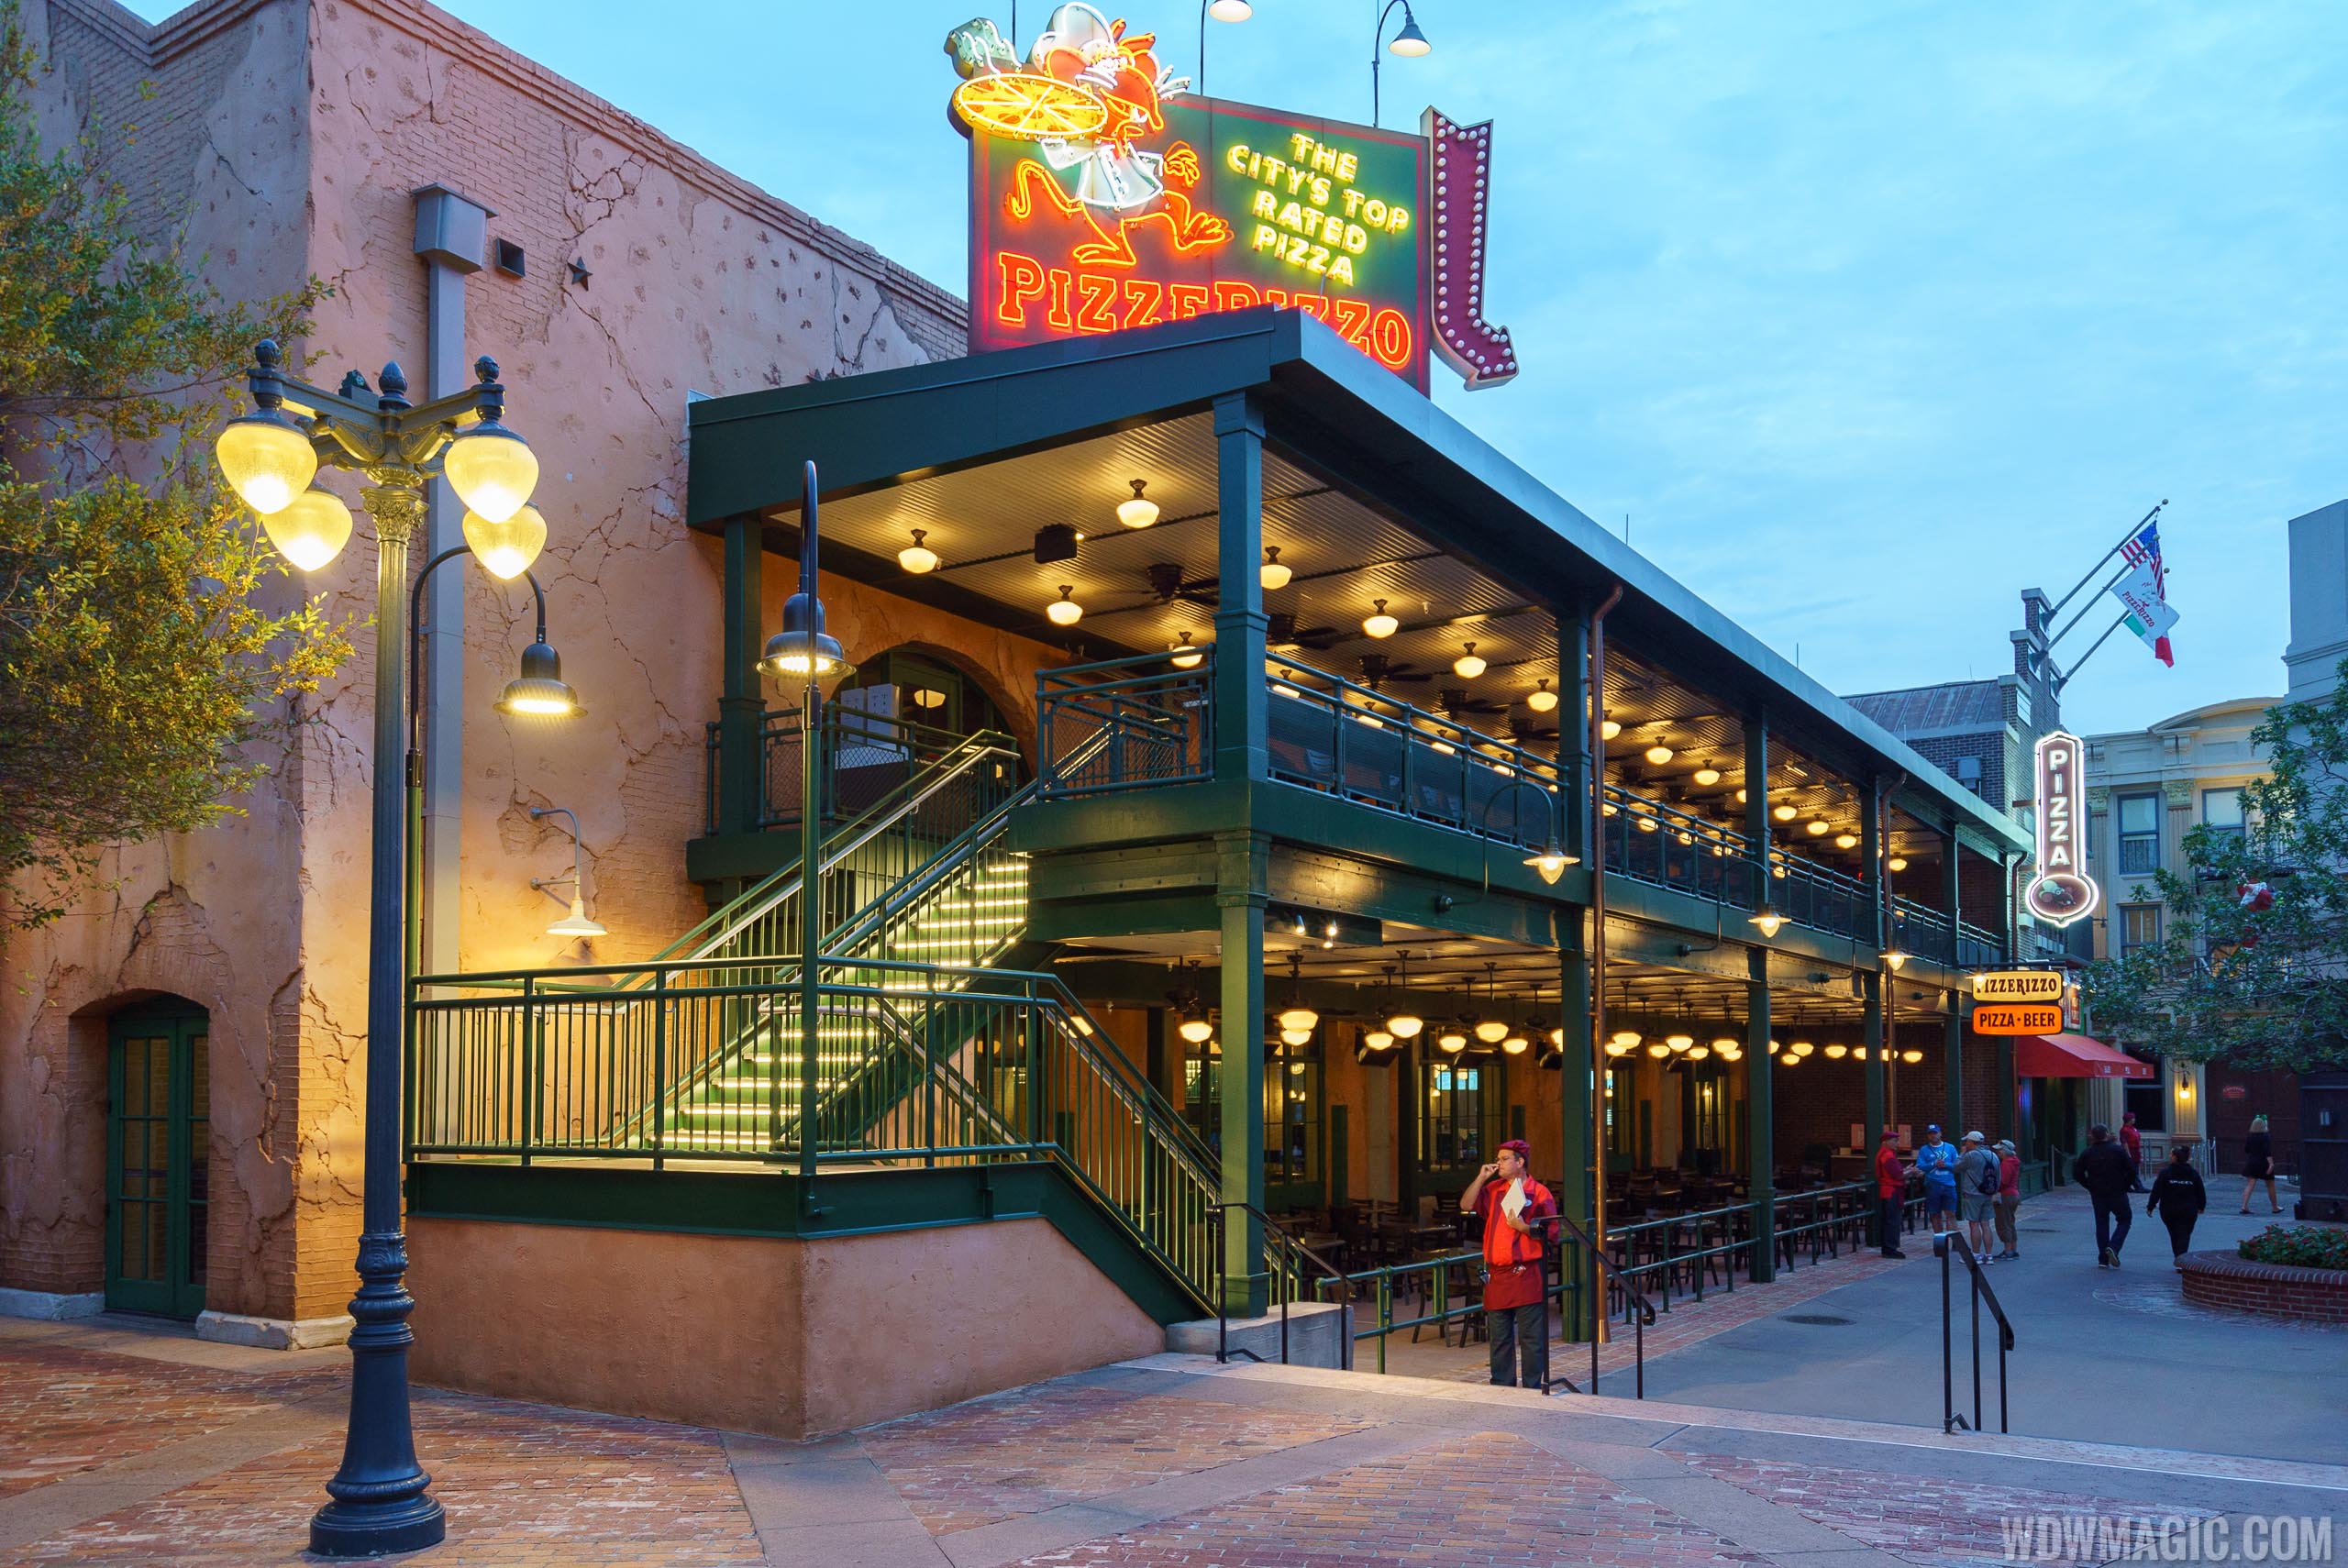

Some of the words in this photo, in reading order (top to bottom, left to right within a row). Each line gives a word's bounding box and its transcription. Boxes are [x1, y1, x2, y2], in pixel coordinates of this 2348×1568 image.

[1290, 133, 1358, 183] THE
[1227, 145, 1331, 206] CITY'S
[1342, 188, 1409, 234] TOP
[1253, 190, 1367, 254] RATED
[1252, 224, 1354, 286] PIZZA
[2049, 749, 2071, 867] PIZZA
[1977, 977, 2057, 995] IZZERIZZO
[1979, 1012, 2015, 1027] PIZZA
[2023, 1012, 2055, 1027] BEER
